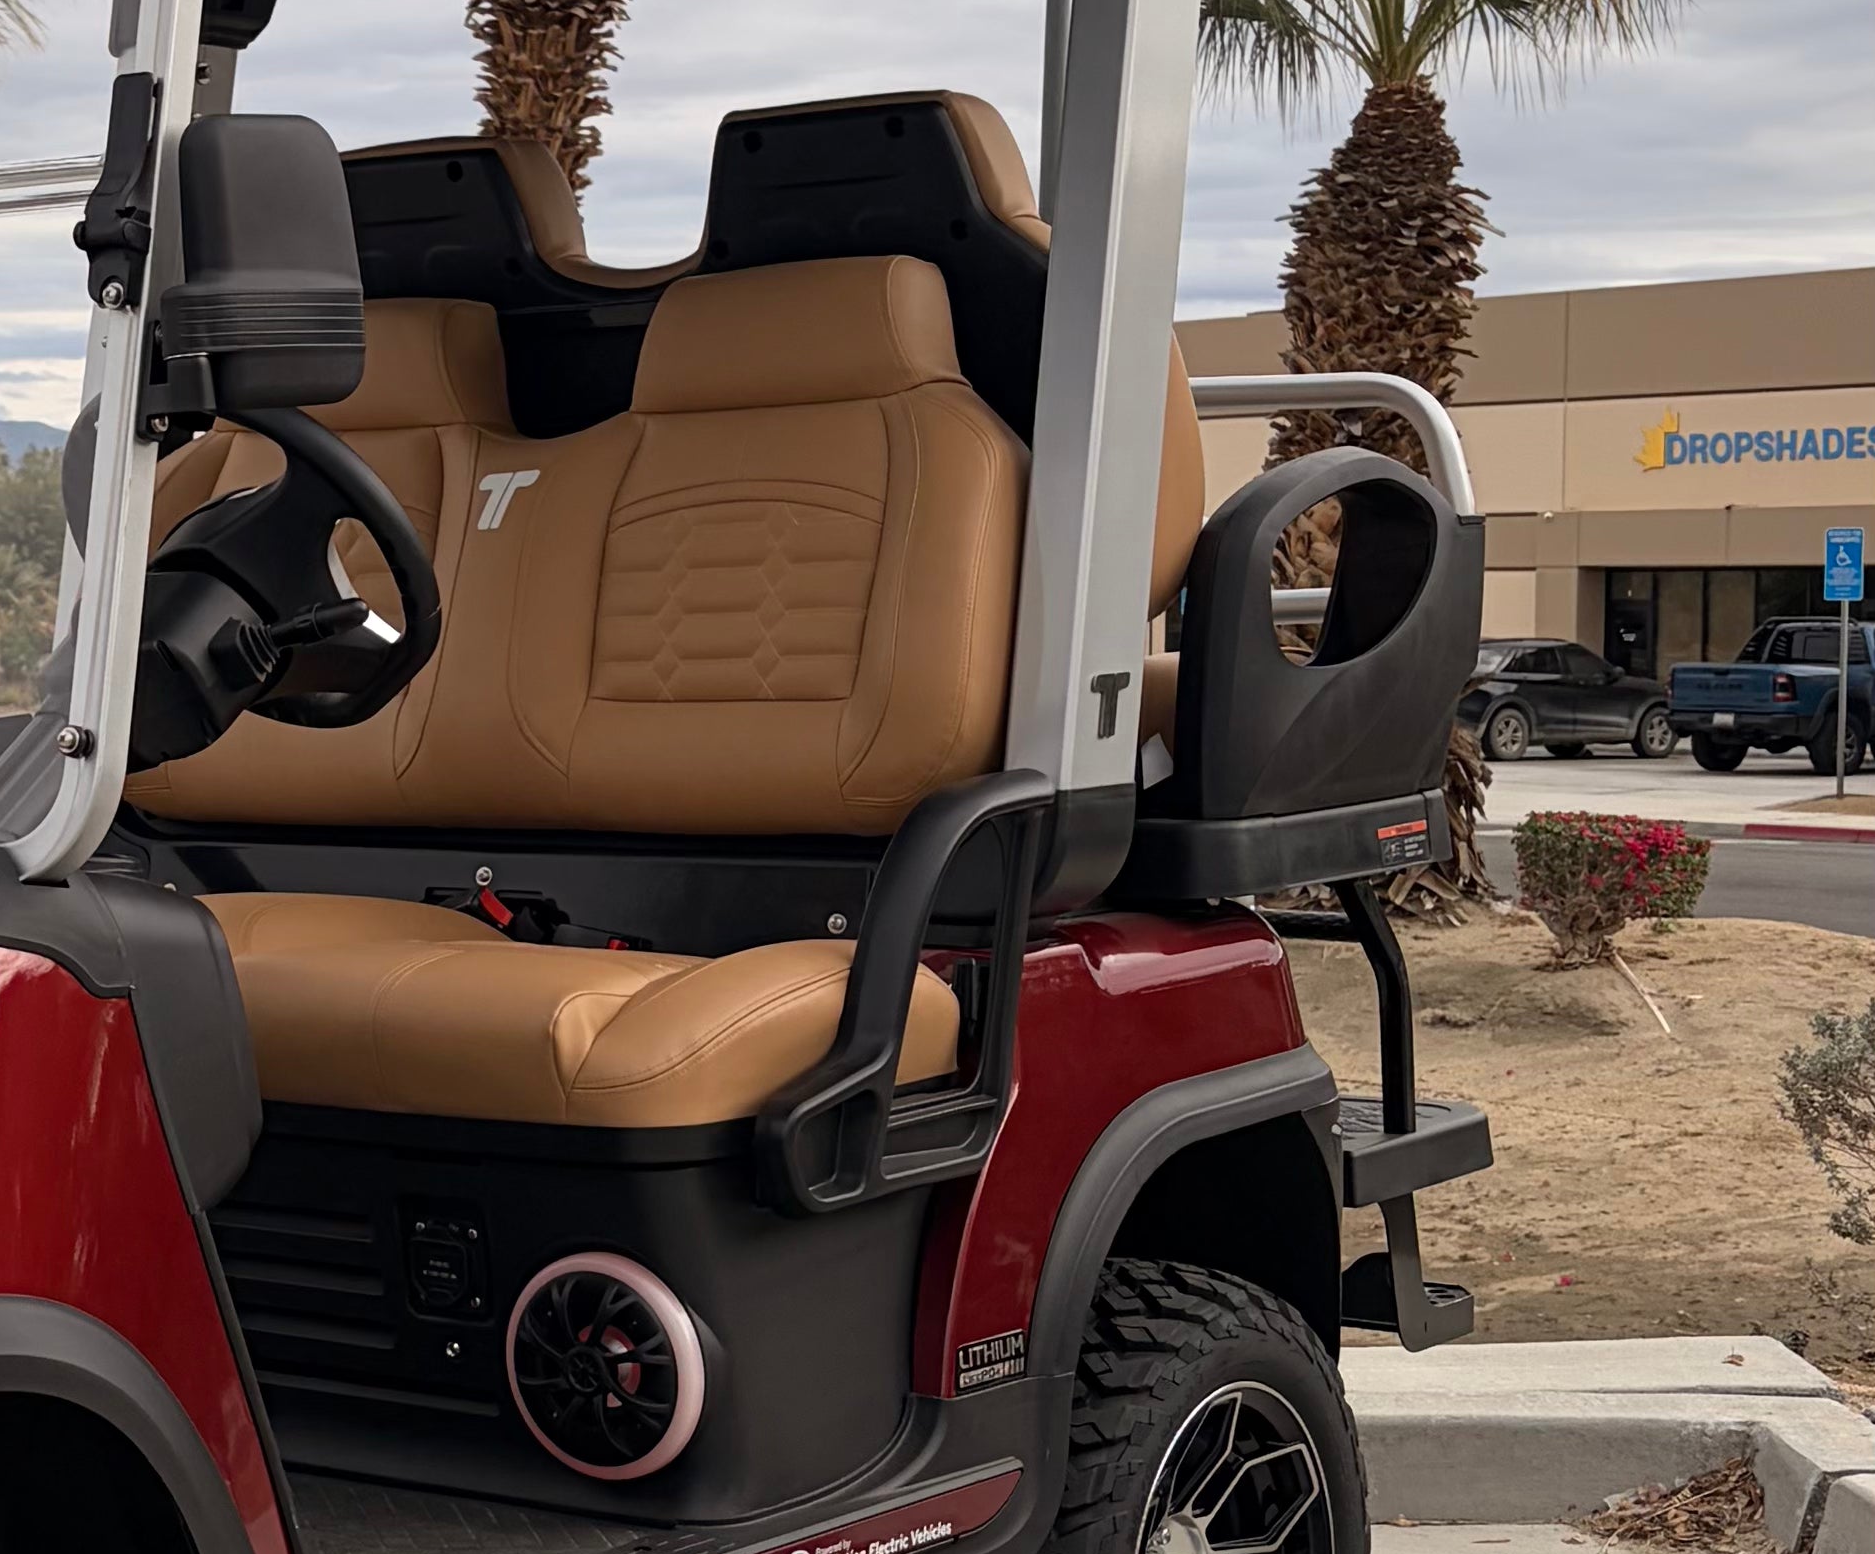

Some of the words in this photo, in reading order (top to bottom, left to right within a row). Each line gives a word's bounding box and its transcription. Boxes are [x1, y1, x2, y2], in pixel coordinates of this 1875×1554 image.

[959, 1334, 1025, 1370] LITHIUM
[842, 1538, 852, 1551] by
[910, 1522, 952, 1546] Vehicles
